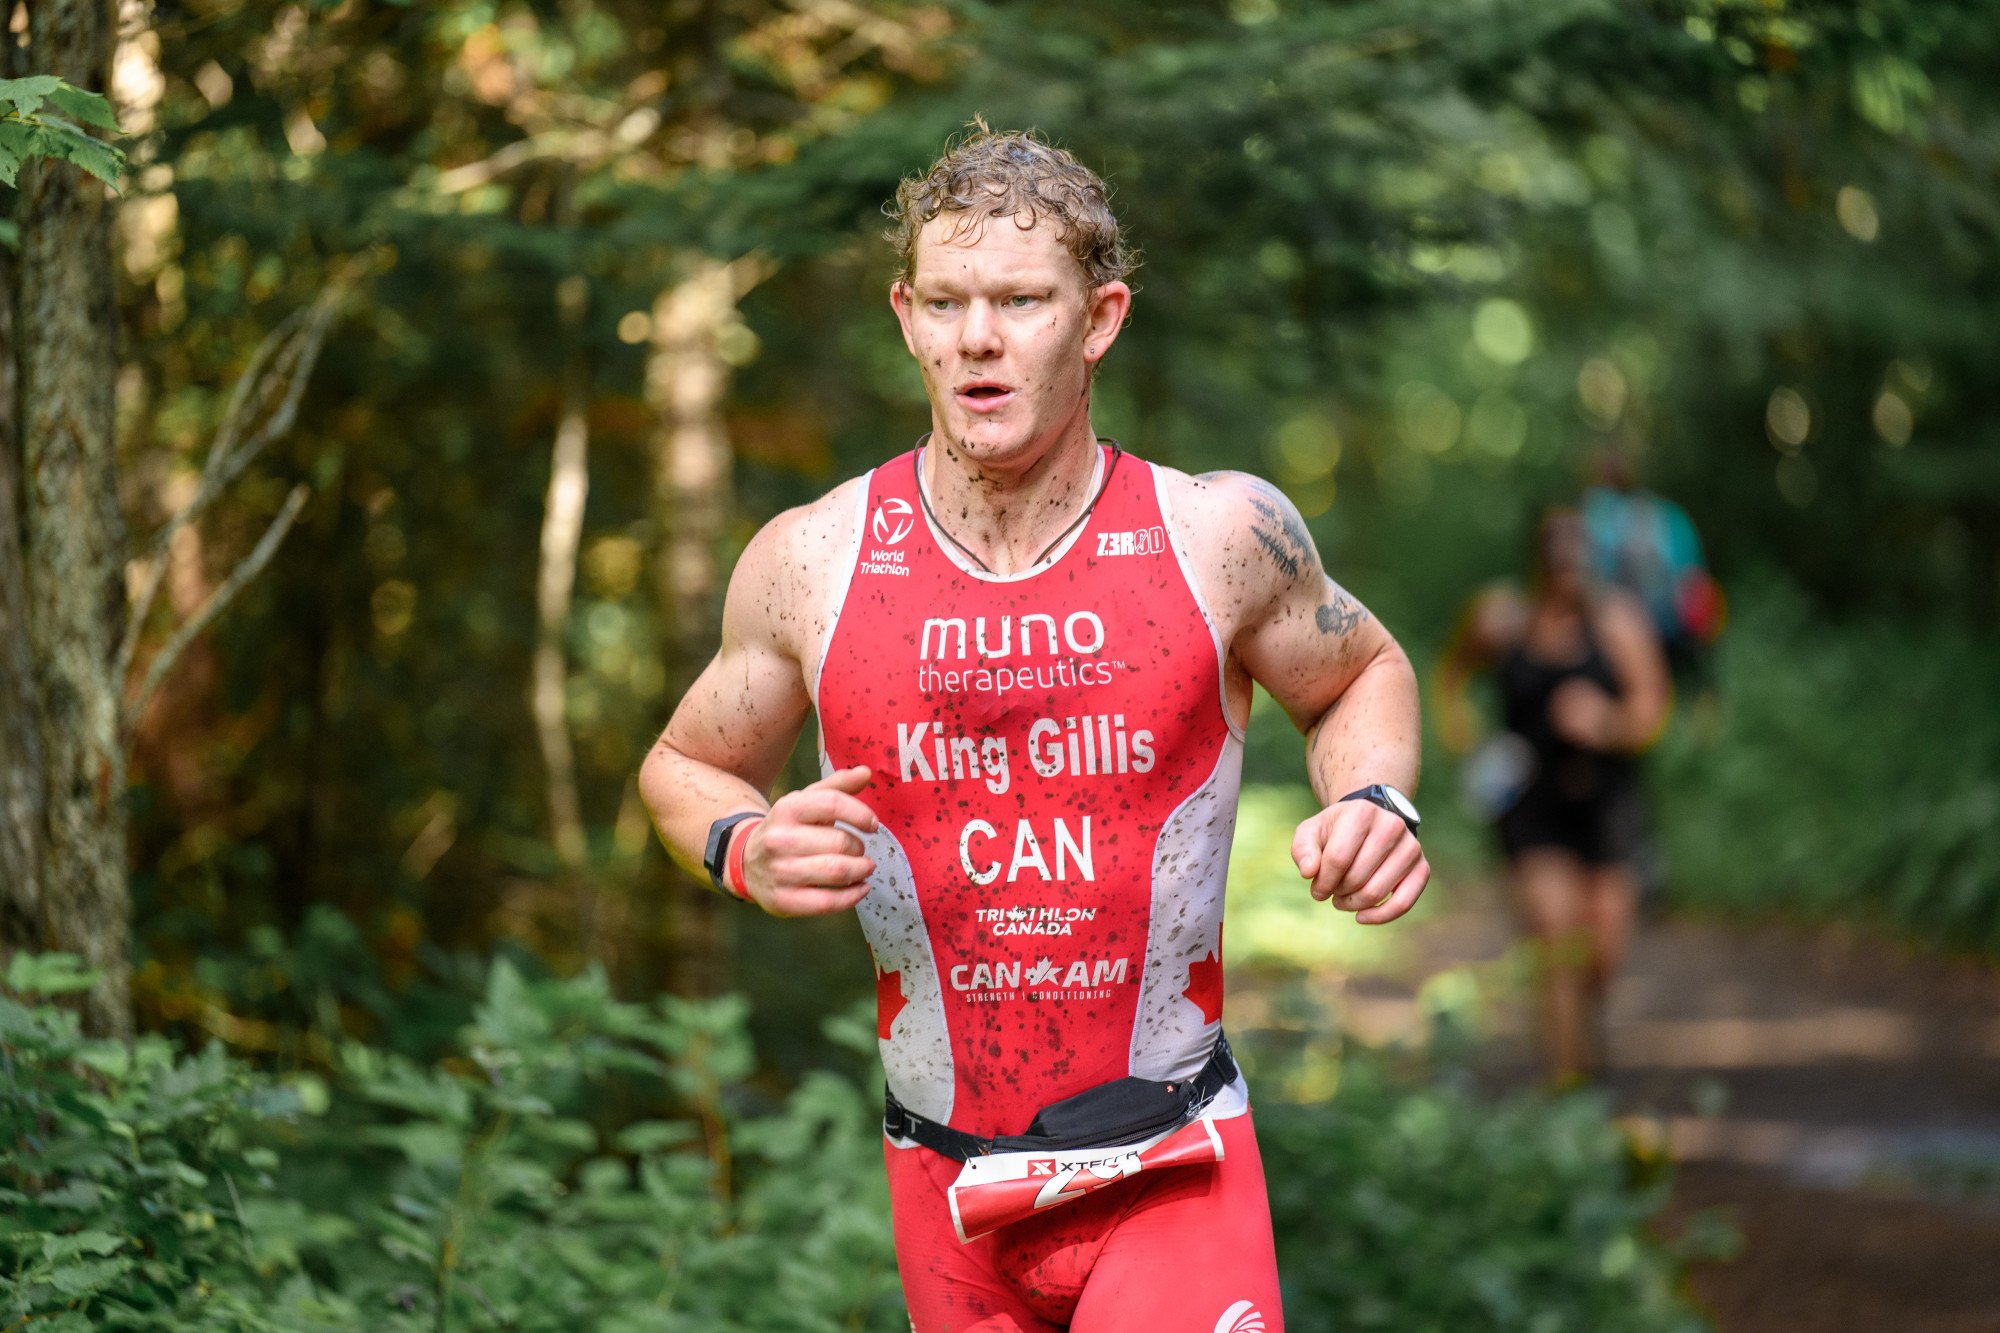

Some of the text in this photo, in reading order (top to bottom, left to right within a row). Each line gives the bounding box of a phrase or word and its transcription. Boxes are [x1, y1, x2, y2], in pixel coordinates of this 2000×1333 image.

[871, 549, 905, 563] World
[860, 562, 910, 577] Triathlon
[920, 611, 1105, 660] muno
[897, 714, 1156, 795] King Gillis
[959, 815, 1095, 885] CAN
[992, 921, 1073, 937] CANADA
[950, 957, 1129, 992] CAN AM
[966, 989, 1112, 1003] STRENGTH CONDITIONING
